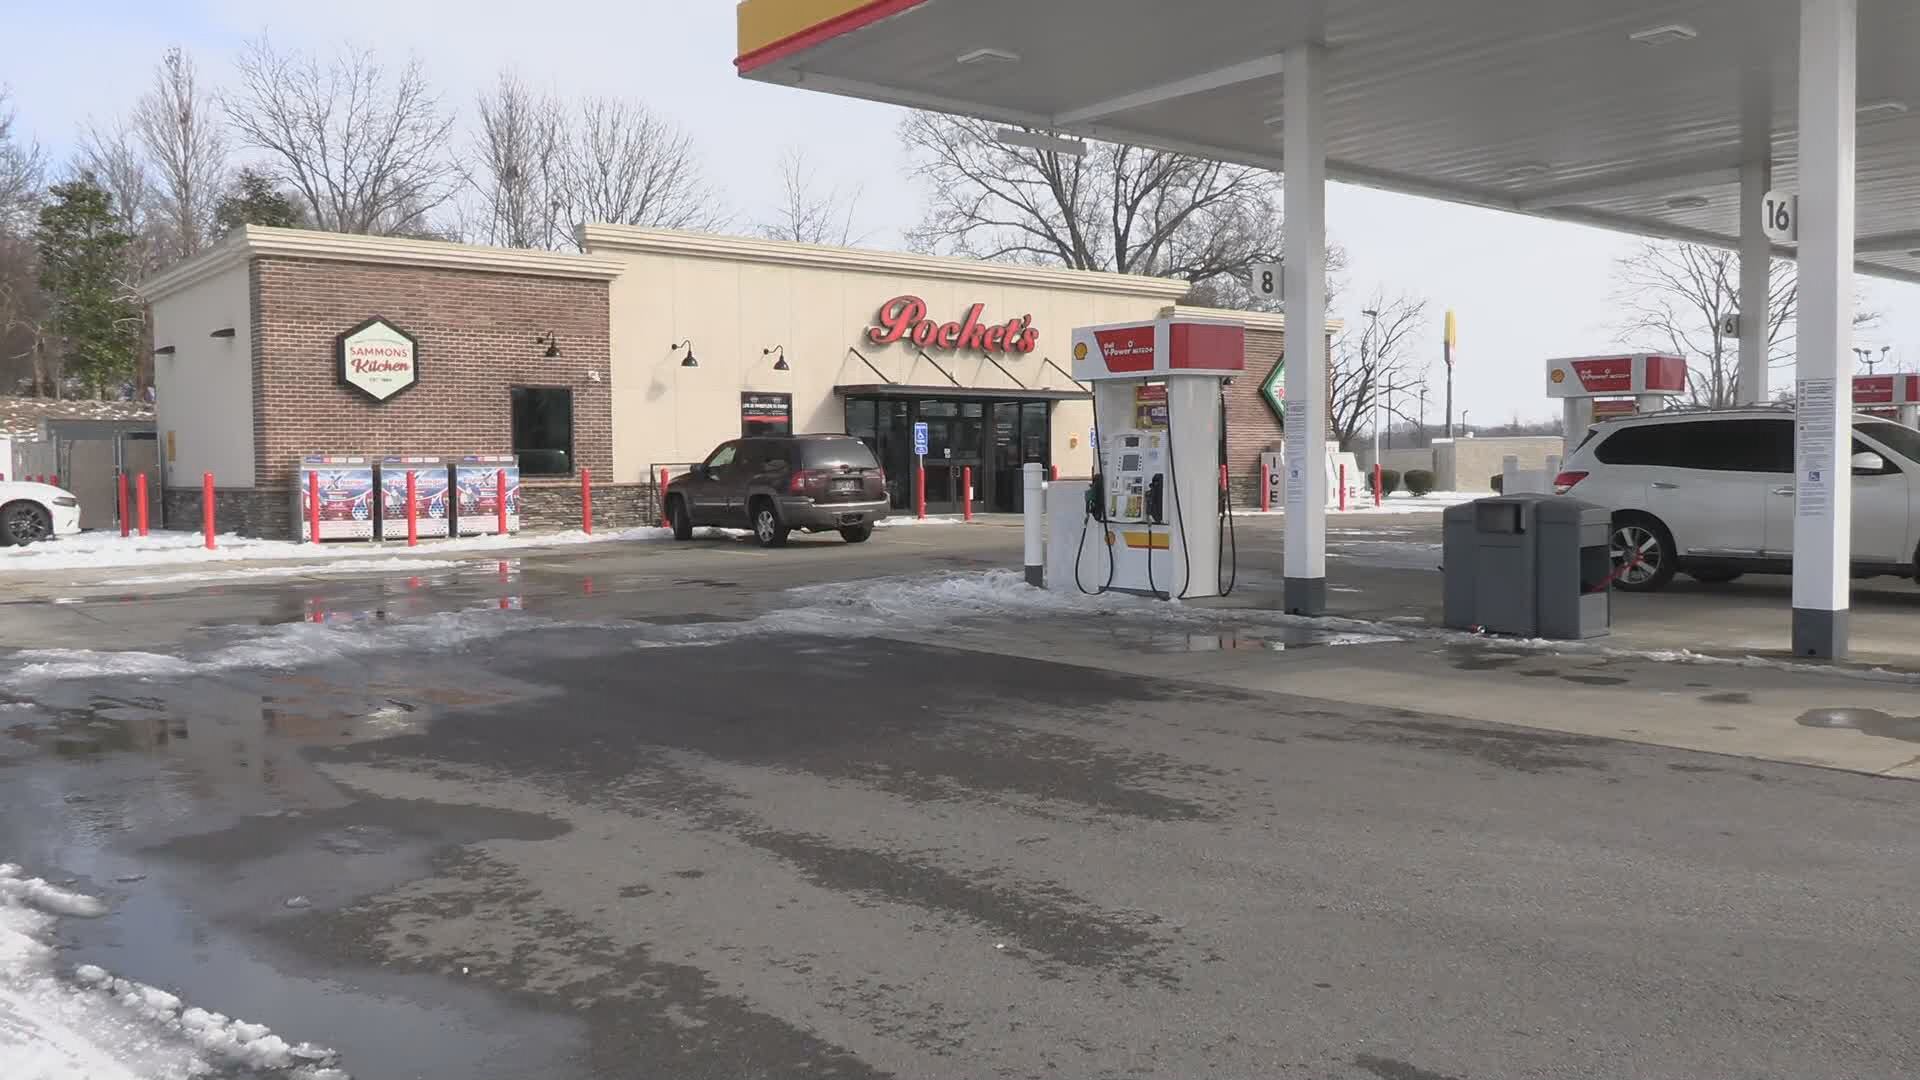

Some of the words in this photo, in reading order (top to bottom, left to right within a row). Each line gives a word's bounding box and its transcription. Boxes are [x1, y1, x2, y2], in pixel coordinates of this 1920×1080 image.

[1766, 199, 1790, 231] 16
[1261, 270, 1274, 294] 8
[868, 294, 1040, 354] Pocket's
[1725, 318, 1733, 334] 6
[1103, 348, 1131, 356] V-Power
[350, 358, 409, 374] Kitchen
[1332, 486, 1356, 499] IE
